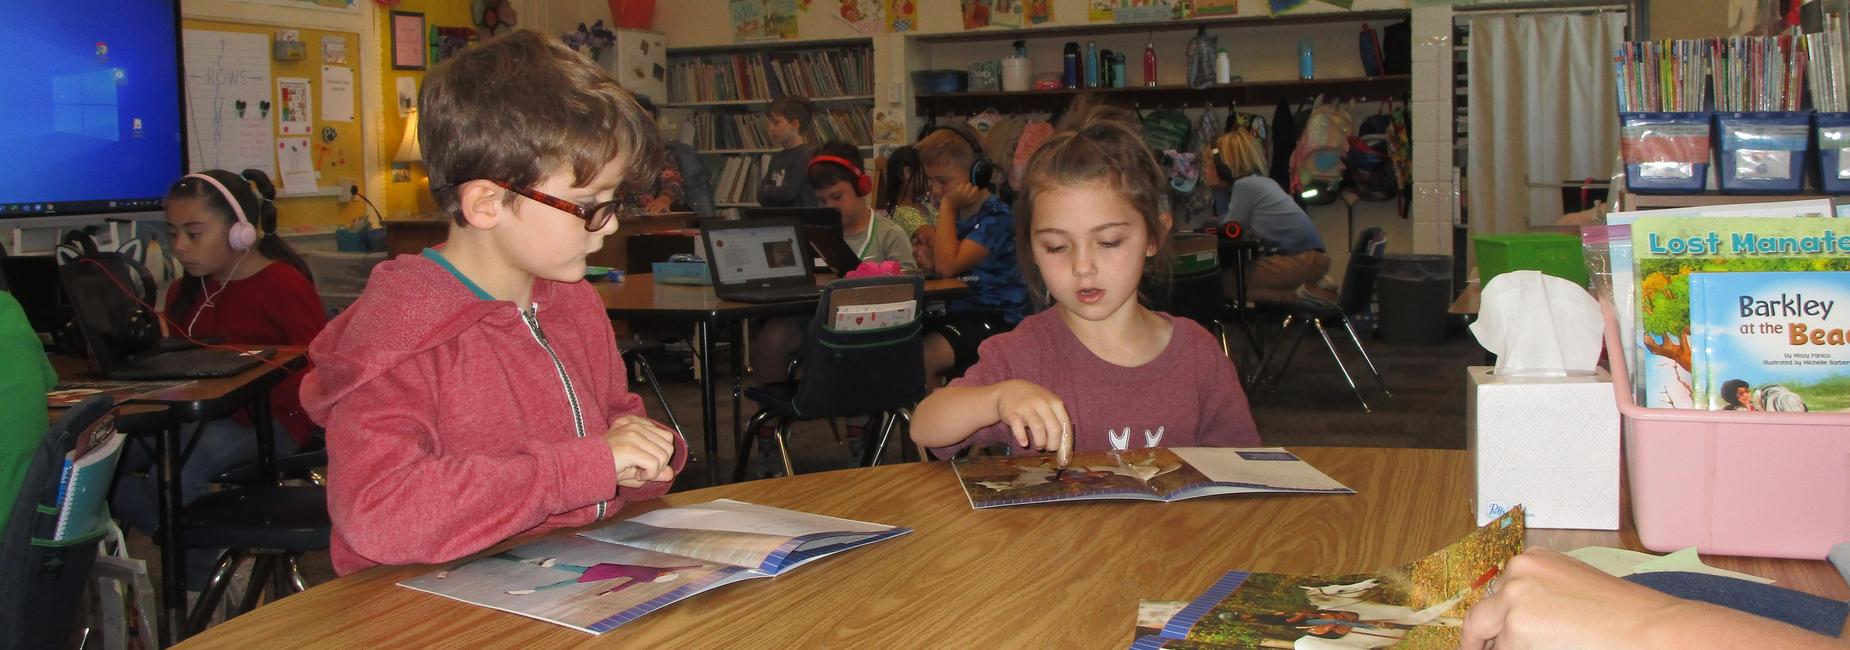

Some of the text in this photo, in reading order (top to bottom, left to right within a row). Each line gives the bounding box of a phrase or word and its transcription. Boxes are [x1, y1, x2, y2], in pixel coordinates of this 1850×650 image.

[207, 68, 247, 86] ROWS
[1648, 231, 1720, 254] Lost
[1739, 293, 1834, 320] Barkley
[1740, 322, 1755, 335] at
[1759, 322, 1783, 334] the
